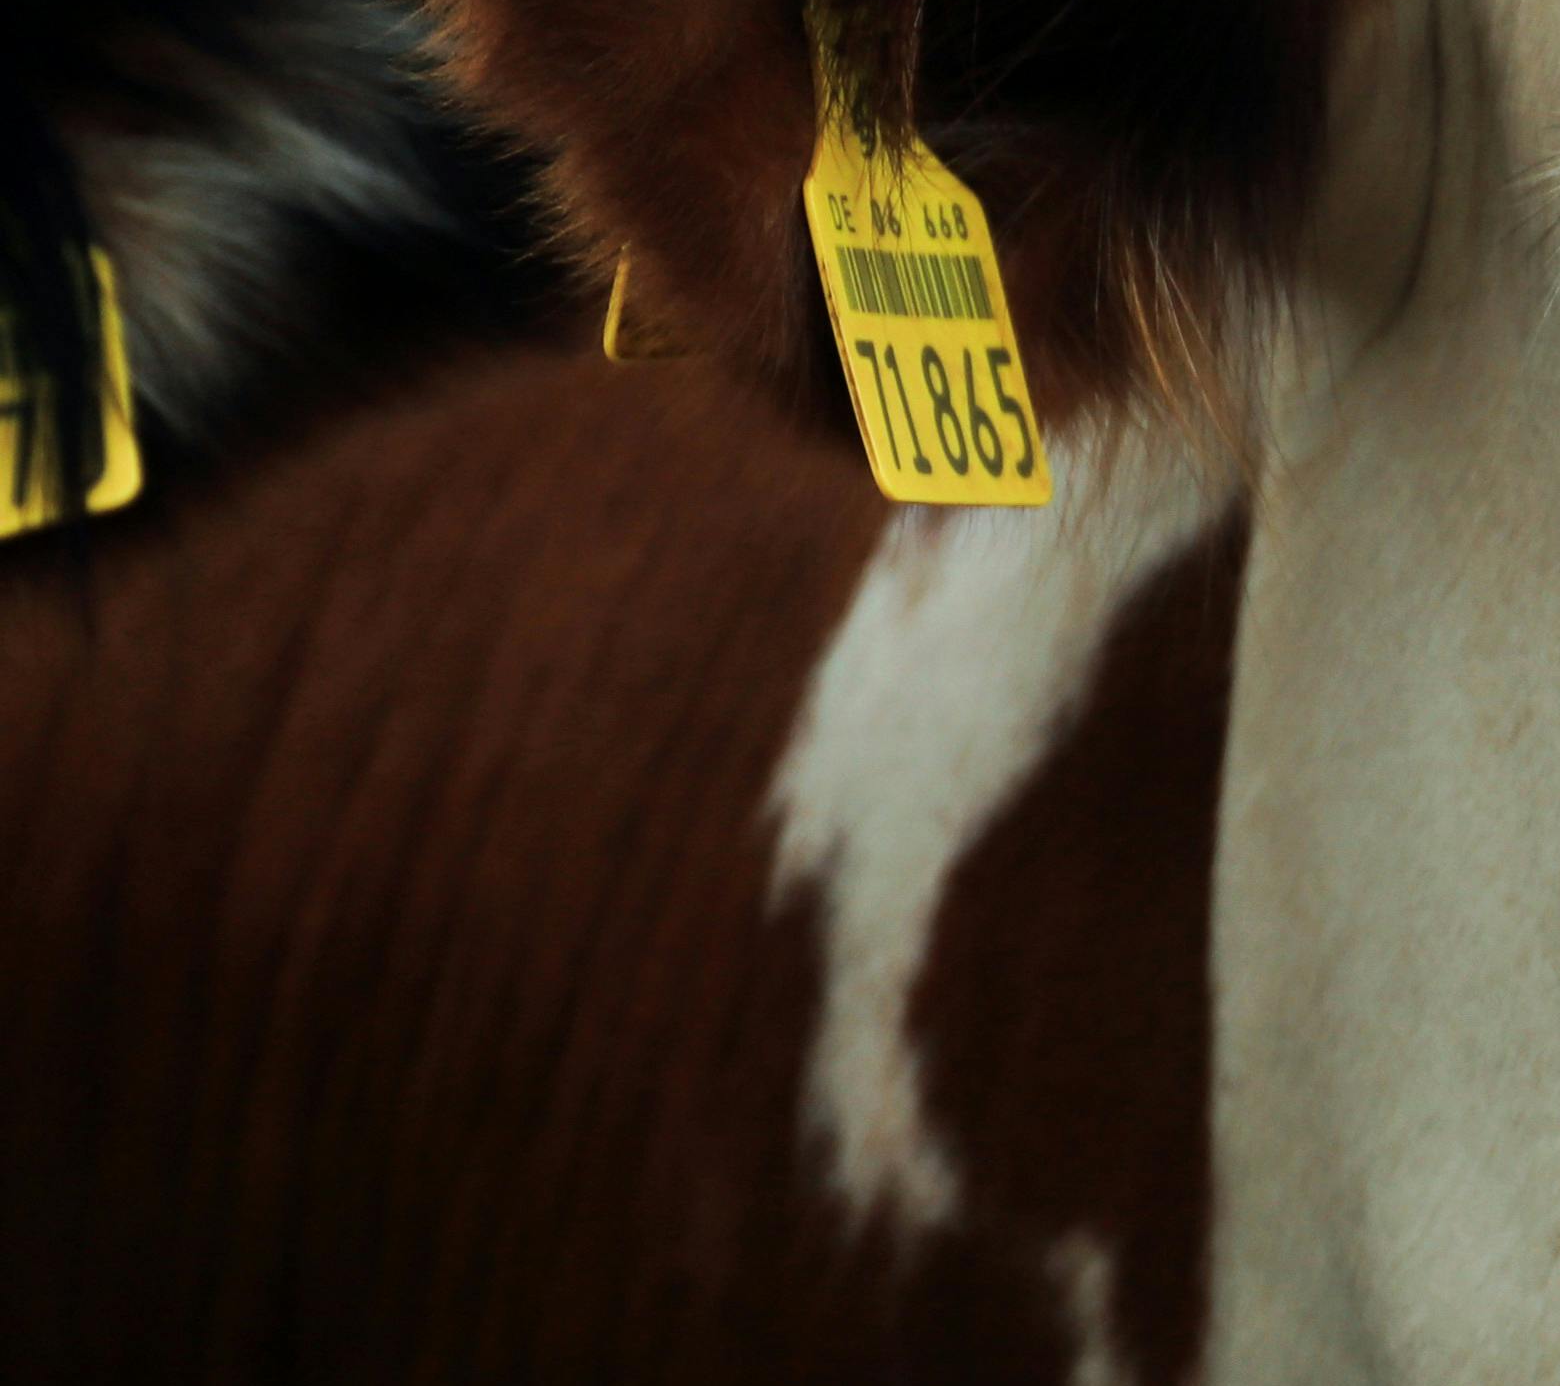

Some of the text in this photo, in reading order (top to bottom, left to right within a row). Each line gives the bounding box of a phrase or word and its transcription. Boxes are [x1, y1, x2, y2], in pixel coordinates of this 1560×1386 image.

[827, 192, 969, 241] DE 06 668
